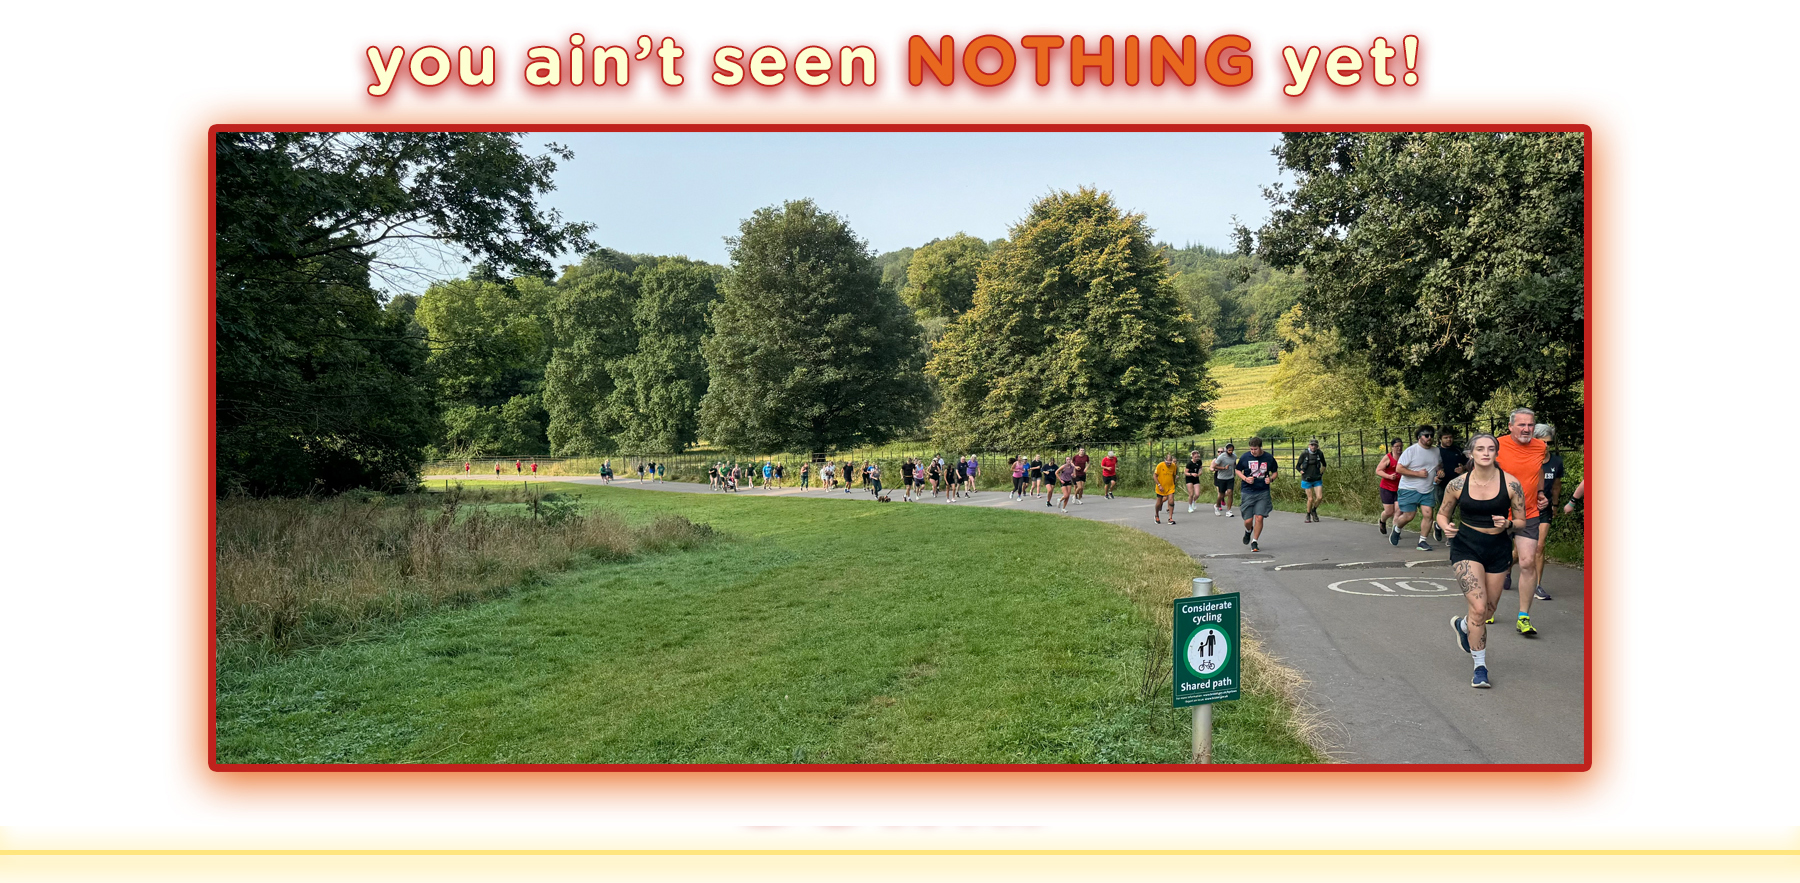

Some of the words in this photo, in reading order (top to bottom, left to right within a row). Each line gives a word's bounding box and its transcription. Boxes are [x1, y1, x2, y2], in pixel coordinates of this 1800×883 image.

[1182, 601, 1232, 613] Considerate
[1192, 613, 1222, 625] cycling
[1181, 679, 1210, 691] Shared
[1213, 677, 1232, 690] path
